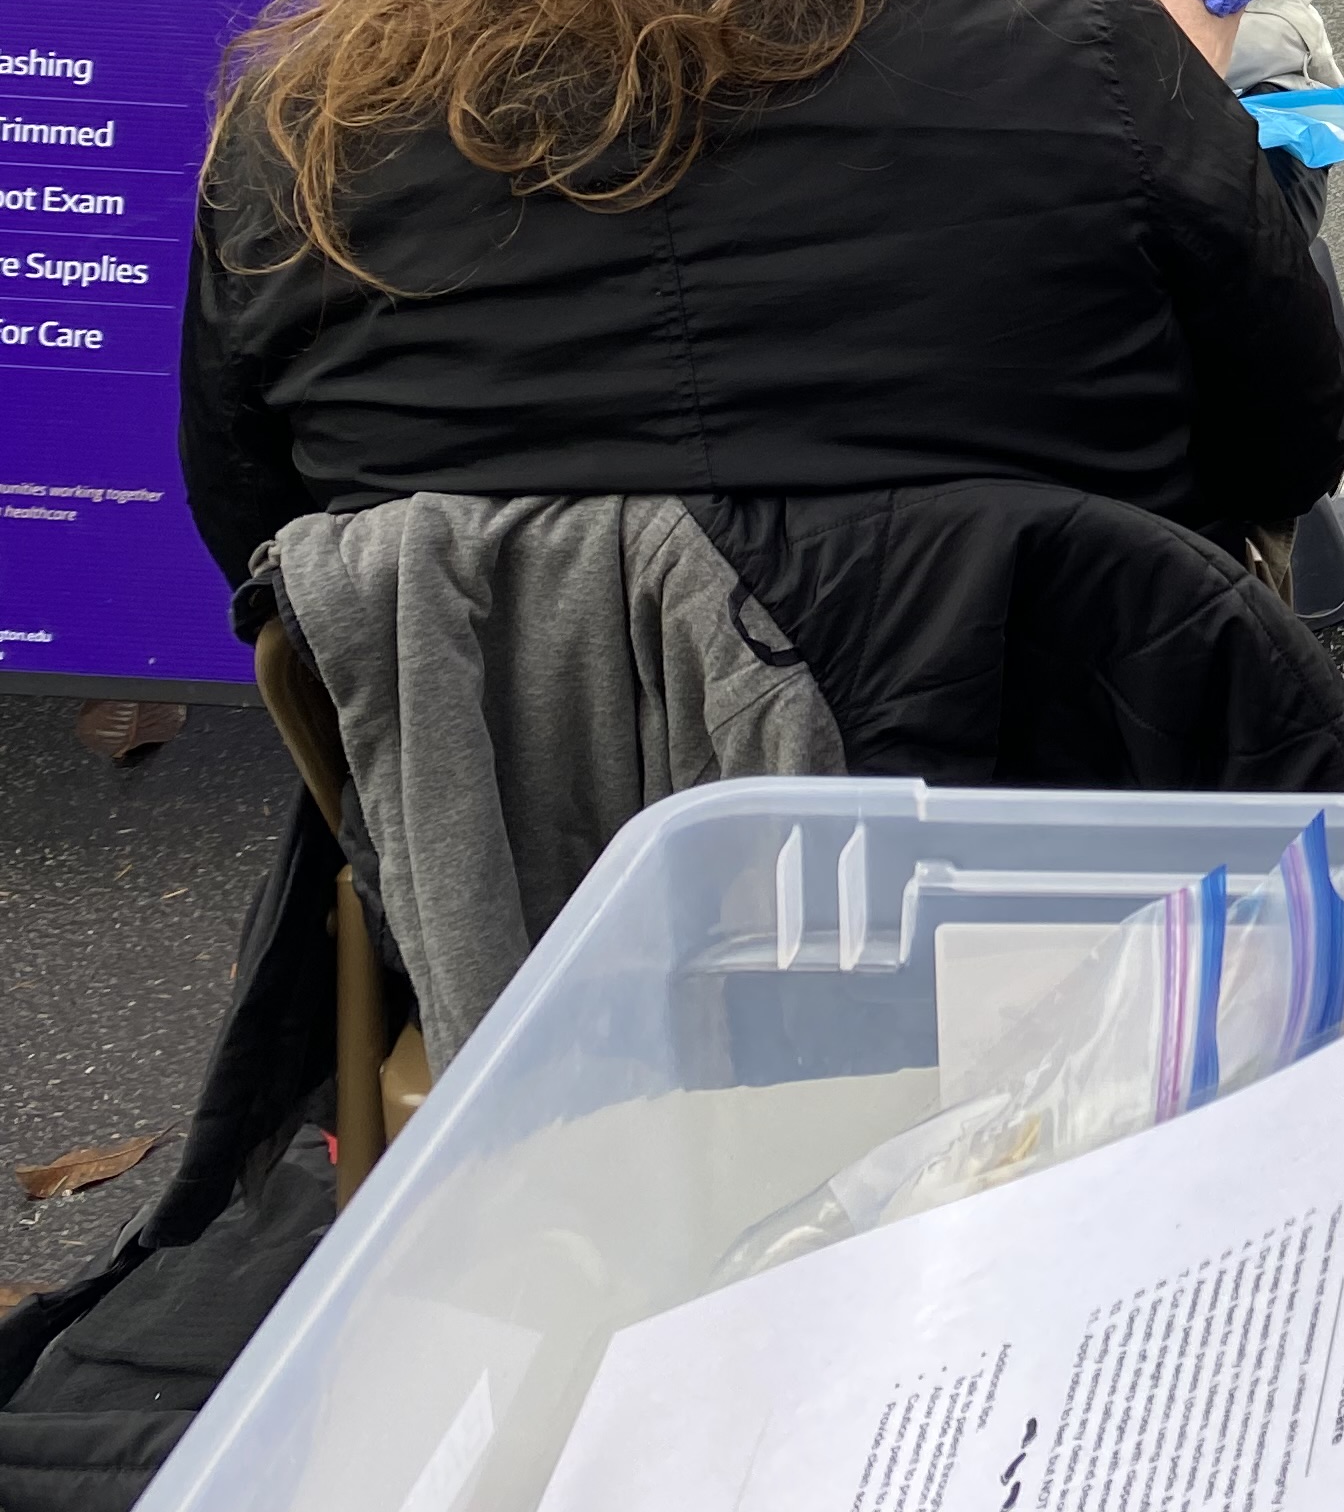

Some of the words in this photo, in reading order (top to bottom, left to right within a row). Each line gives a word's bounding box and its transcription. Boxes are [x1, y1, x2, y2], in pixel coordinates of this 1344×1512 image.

[42, 187, 125, 215] Exam
[25, 252, 149, 287] Supplies
[38, 321, 104, 349] Care
[50, 485, 105, 503] working
[105, 488, 165, 504] together
[5, 505, 77, 522] healthcare
